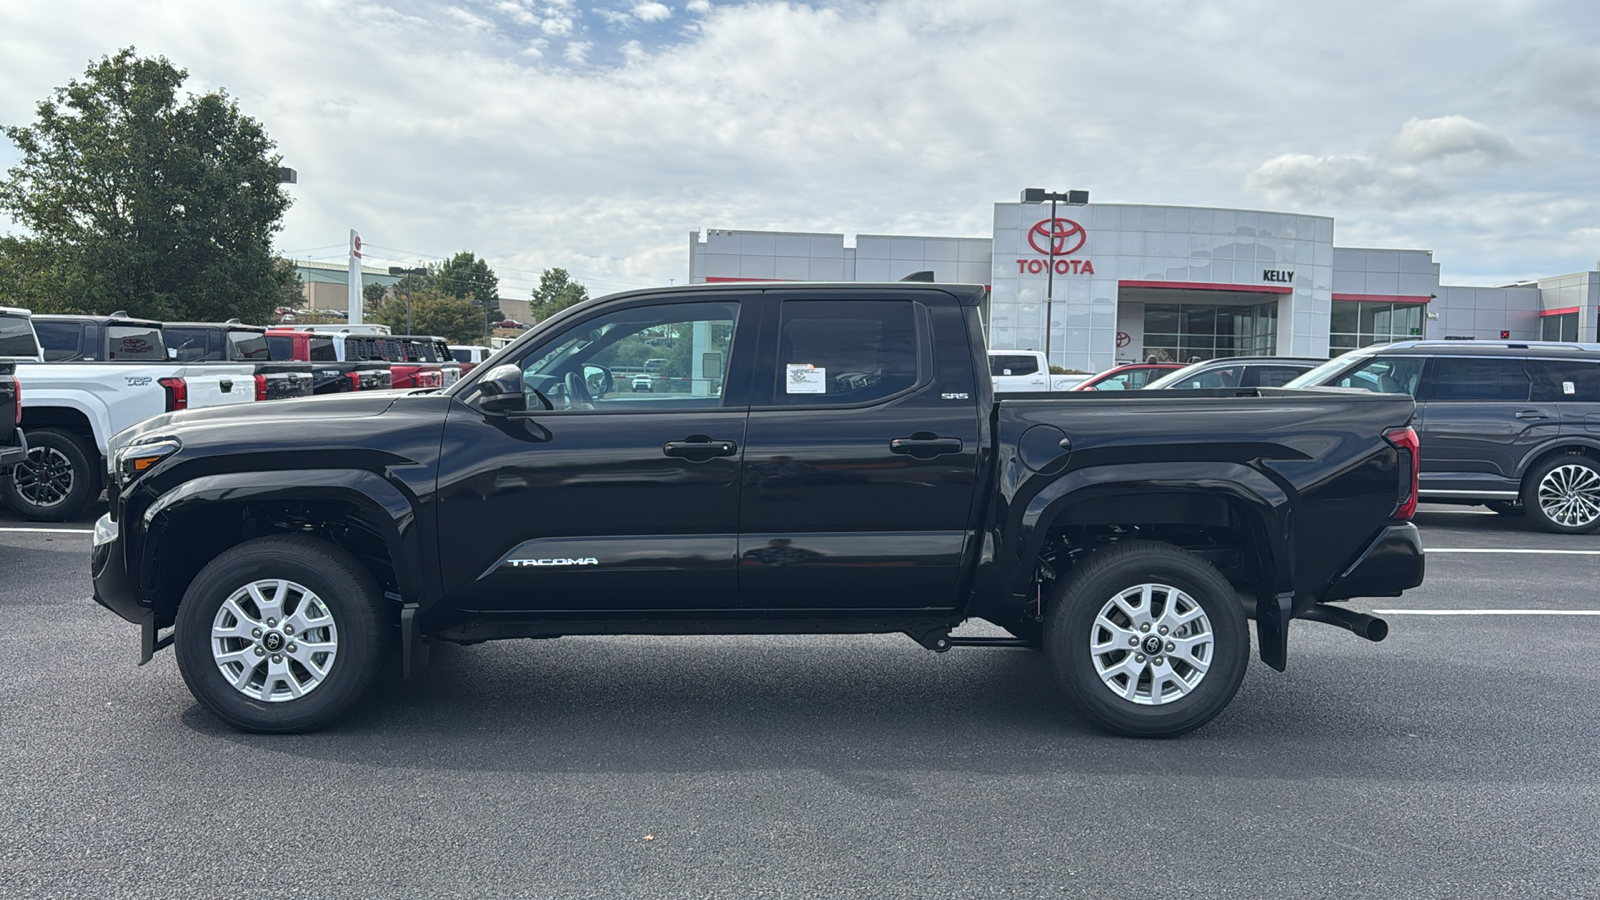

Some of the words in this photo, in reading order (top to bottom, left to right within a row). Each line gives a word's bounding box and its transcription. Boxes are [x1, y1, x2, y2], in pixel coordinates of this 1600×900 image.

[1016, 259, 1094, 275] TOYOTA
[1263, 269, 1294, 283] KELLY
[941, 392, 969, 400] SR5
[507, 557, 599, 567] TACOMA
